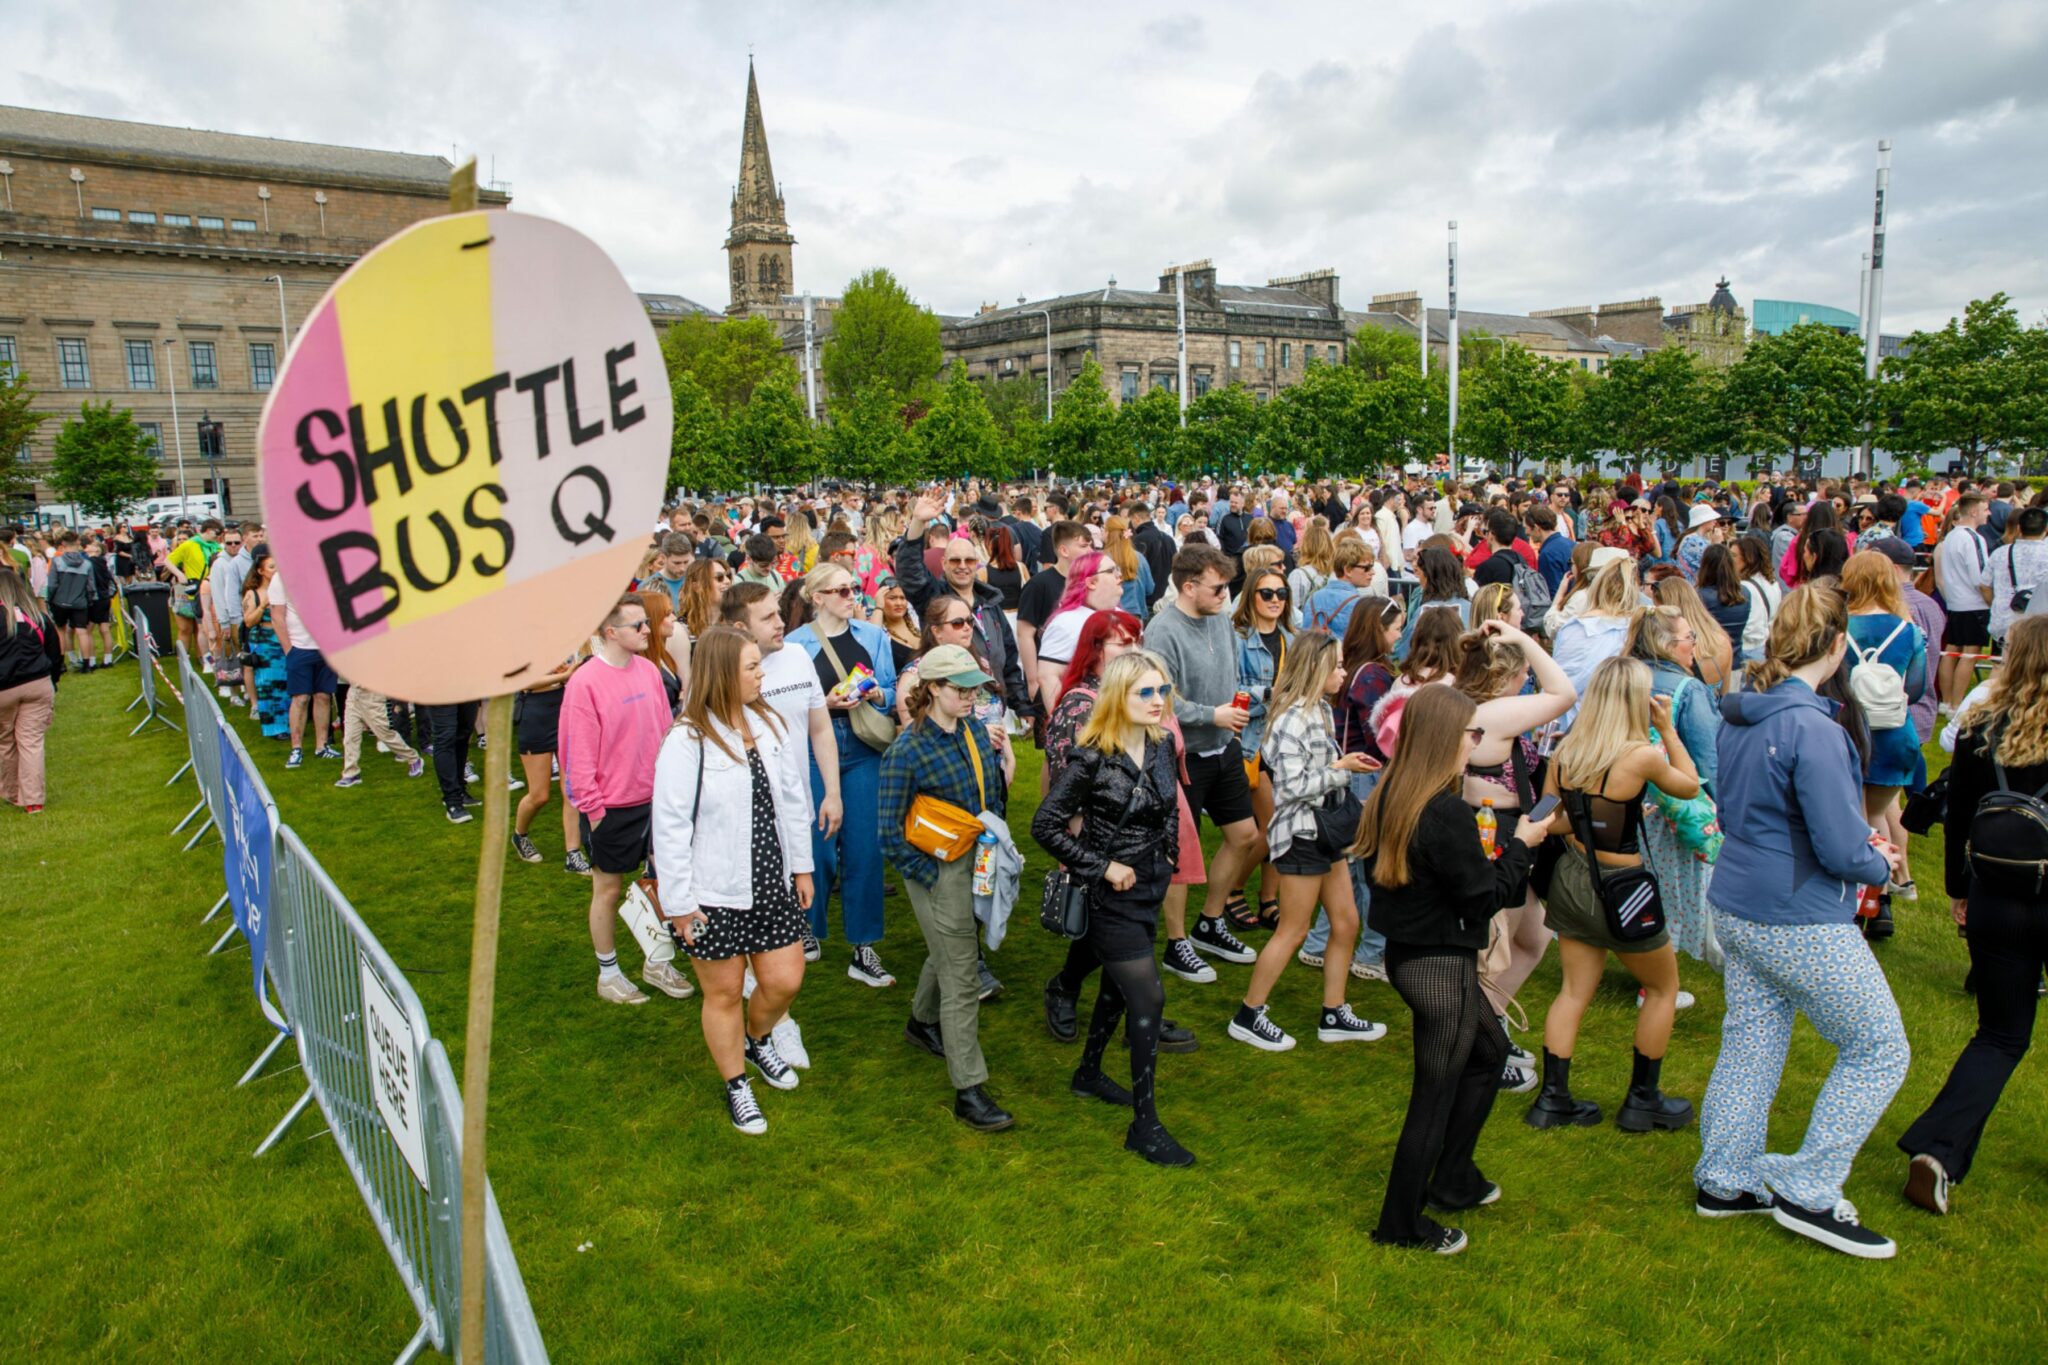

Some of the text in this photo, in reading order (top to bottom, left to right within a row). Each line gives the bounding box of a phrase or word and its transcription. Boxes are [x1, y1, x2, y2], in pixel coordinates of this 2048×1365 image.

[294, 341, 646, 521] SHUTTLE
[319, 465, 616, 633] BUS Q
[369, 1004, 410, 1091] QUEUE
[377, 1055, 409, 1131] HERE
